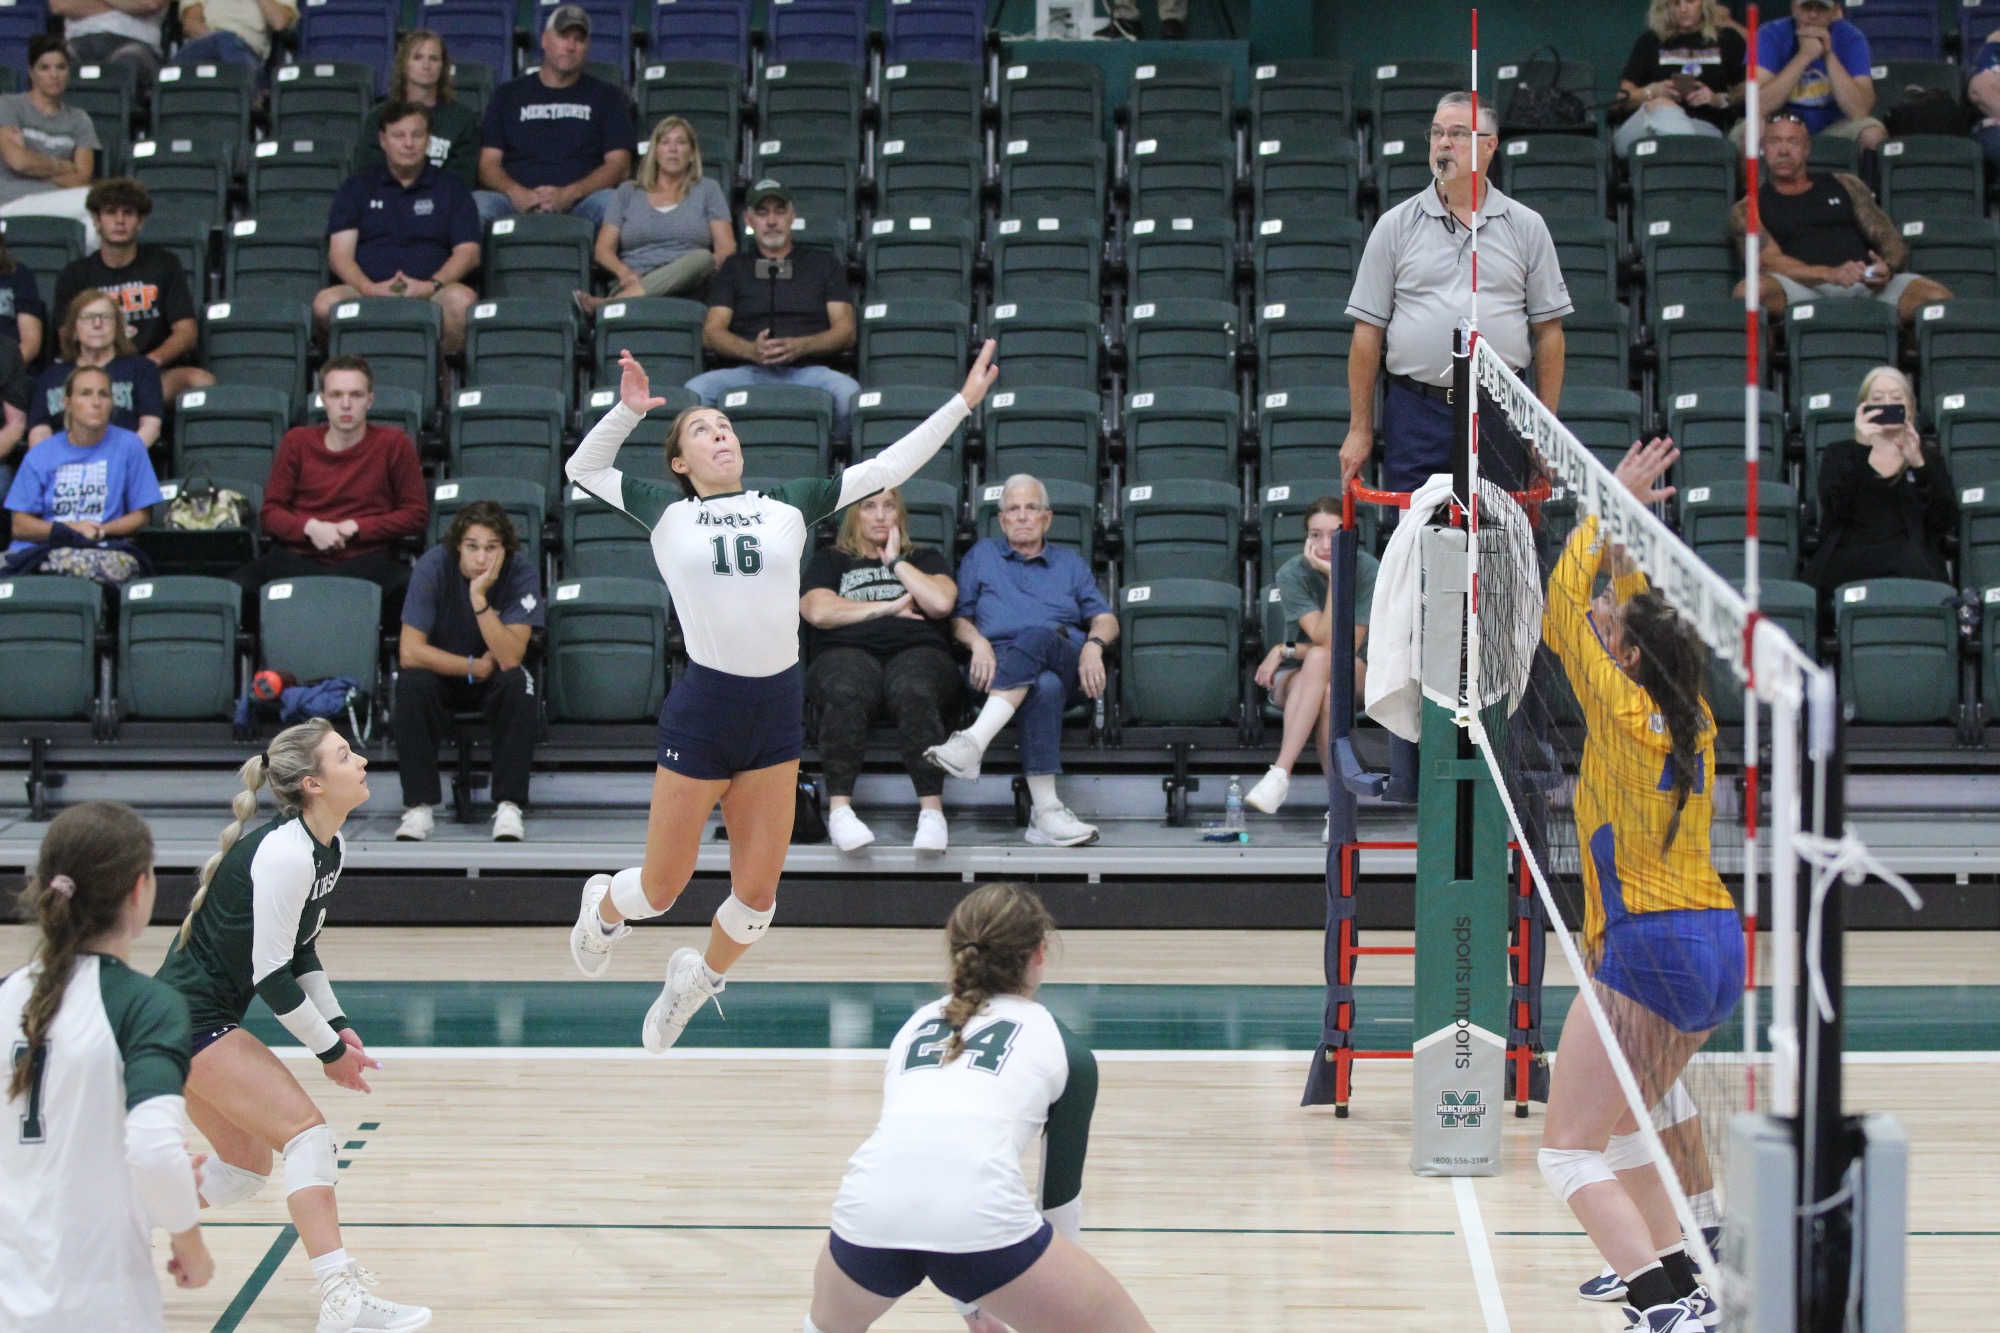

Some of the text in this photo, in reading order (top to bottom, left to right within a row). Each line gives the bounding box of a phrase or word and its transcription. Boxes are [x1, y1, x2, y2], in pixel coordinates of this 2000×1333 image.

[520, 103, 592, 121] MERCYHURST
[1002, 307, 1011, 315] 22
[1139, 307, 1149, 315] 23
[999, 396, 1009, 404] 22
[1138, 396, 1148, 405] 23
[1272, 396, 1282, 404] 24
[1682, 397, 1692, 406] 27
[990, 489, 1001, 497] 22
[1136, 489, 1146, 498] 23
[1273, 489, 1285, 498] 24
[1694, 490, 1705, 499] 27
[1968, 491, 1979, 500] 29
[696, 511, 765, 529] HURST
[710, 533, 764, 577] 16
[1134, 590, 1145, 599] 23
[1452, 915, 1473, 1069] sports imports
[901, 1017, 1023, 1076] 24
[1437, 1104, 1486, 1113] MERCYHURST
[1432, 1157, 1489, 1165] (800) 556-3198
